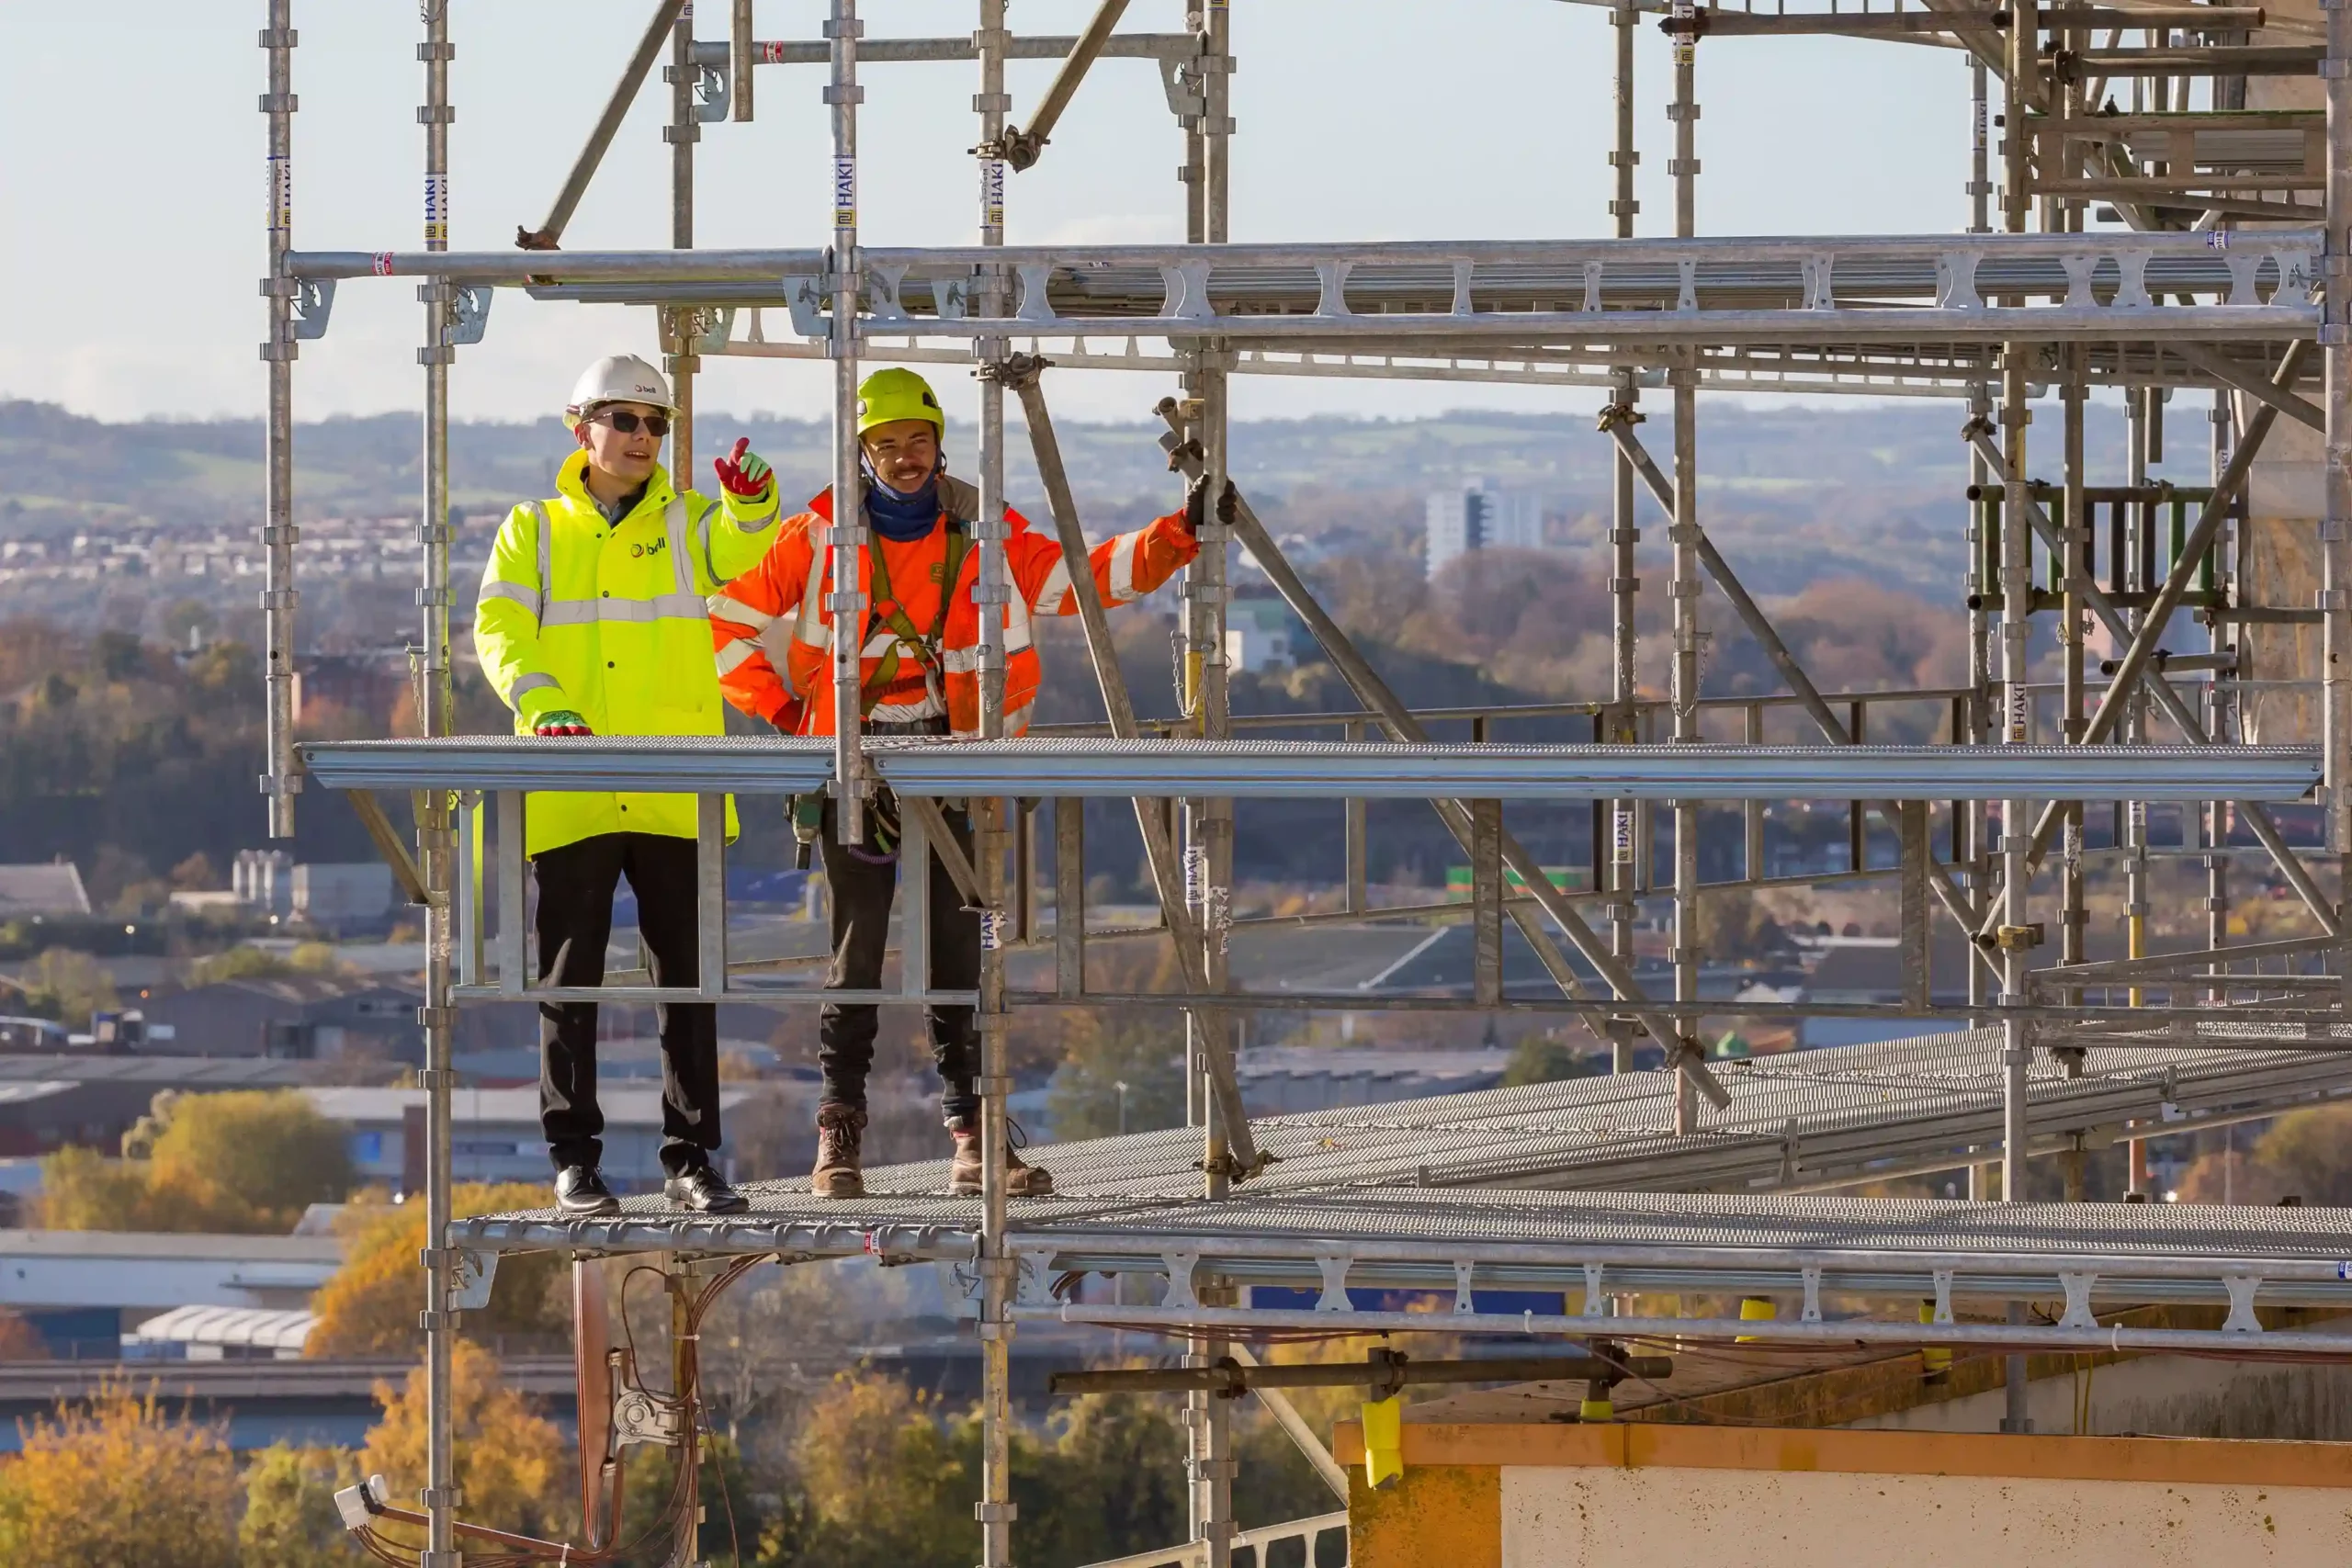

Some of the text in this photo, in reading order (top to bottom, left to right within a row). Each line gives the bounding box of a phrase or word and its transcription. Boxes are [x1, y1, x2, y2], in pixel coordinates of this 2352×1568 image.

[425, 179, 436, 220] HAKI
[838, 164, 853, 206] HAKI
[991, 164, 1003, 204] HAKI
[643, 385, 657, 394] bell
[2014, 688, 2025, 724] HAKI
[1617, 815, 1628, 847] HAKI
[982, 911, 993, 948] HAK
